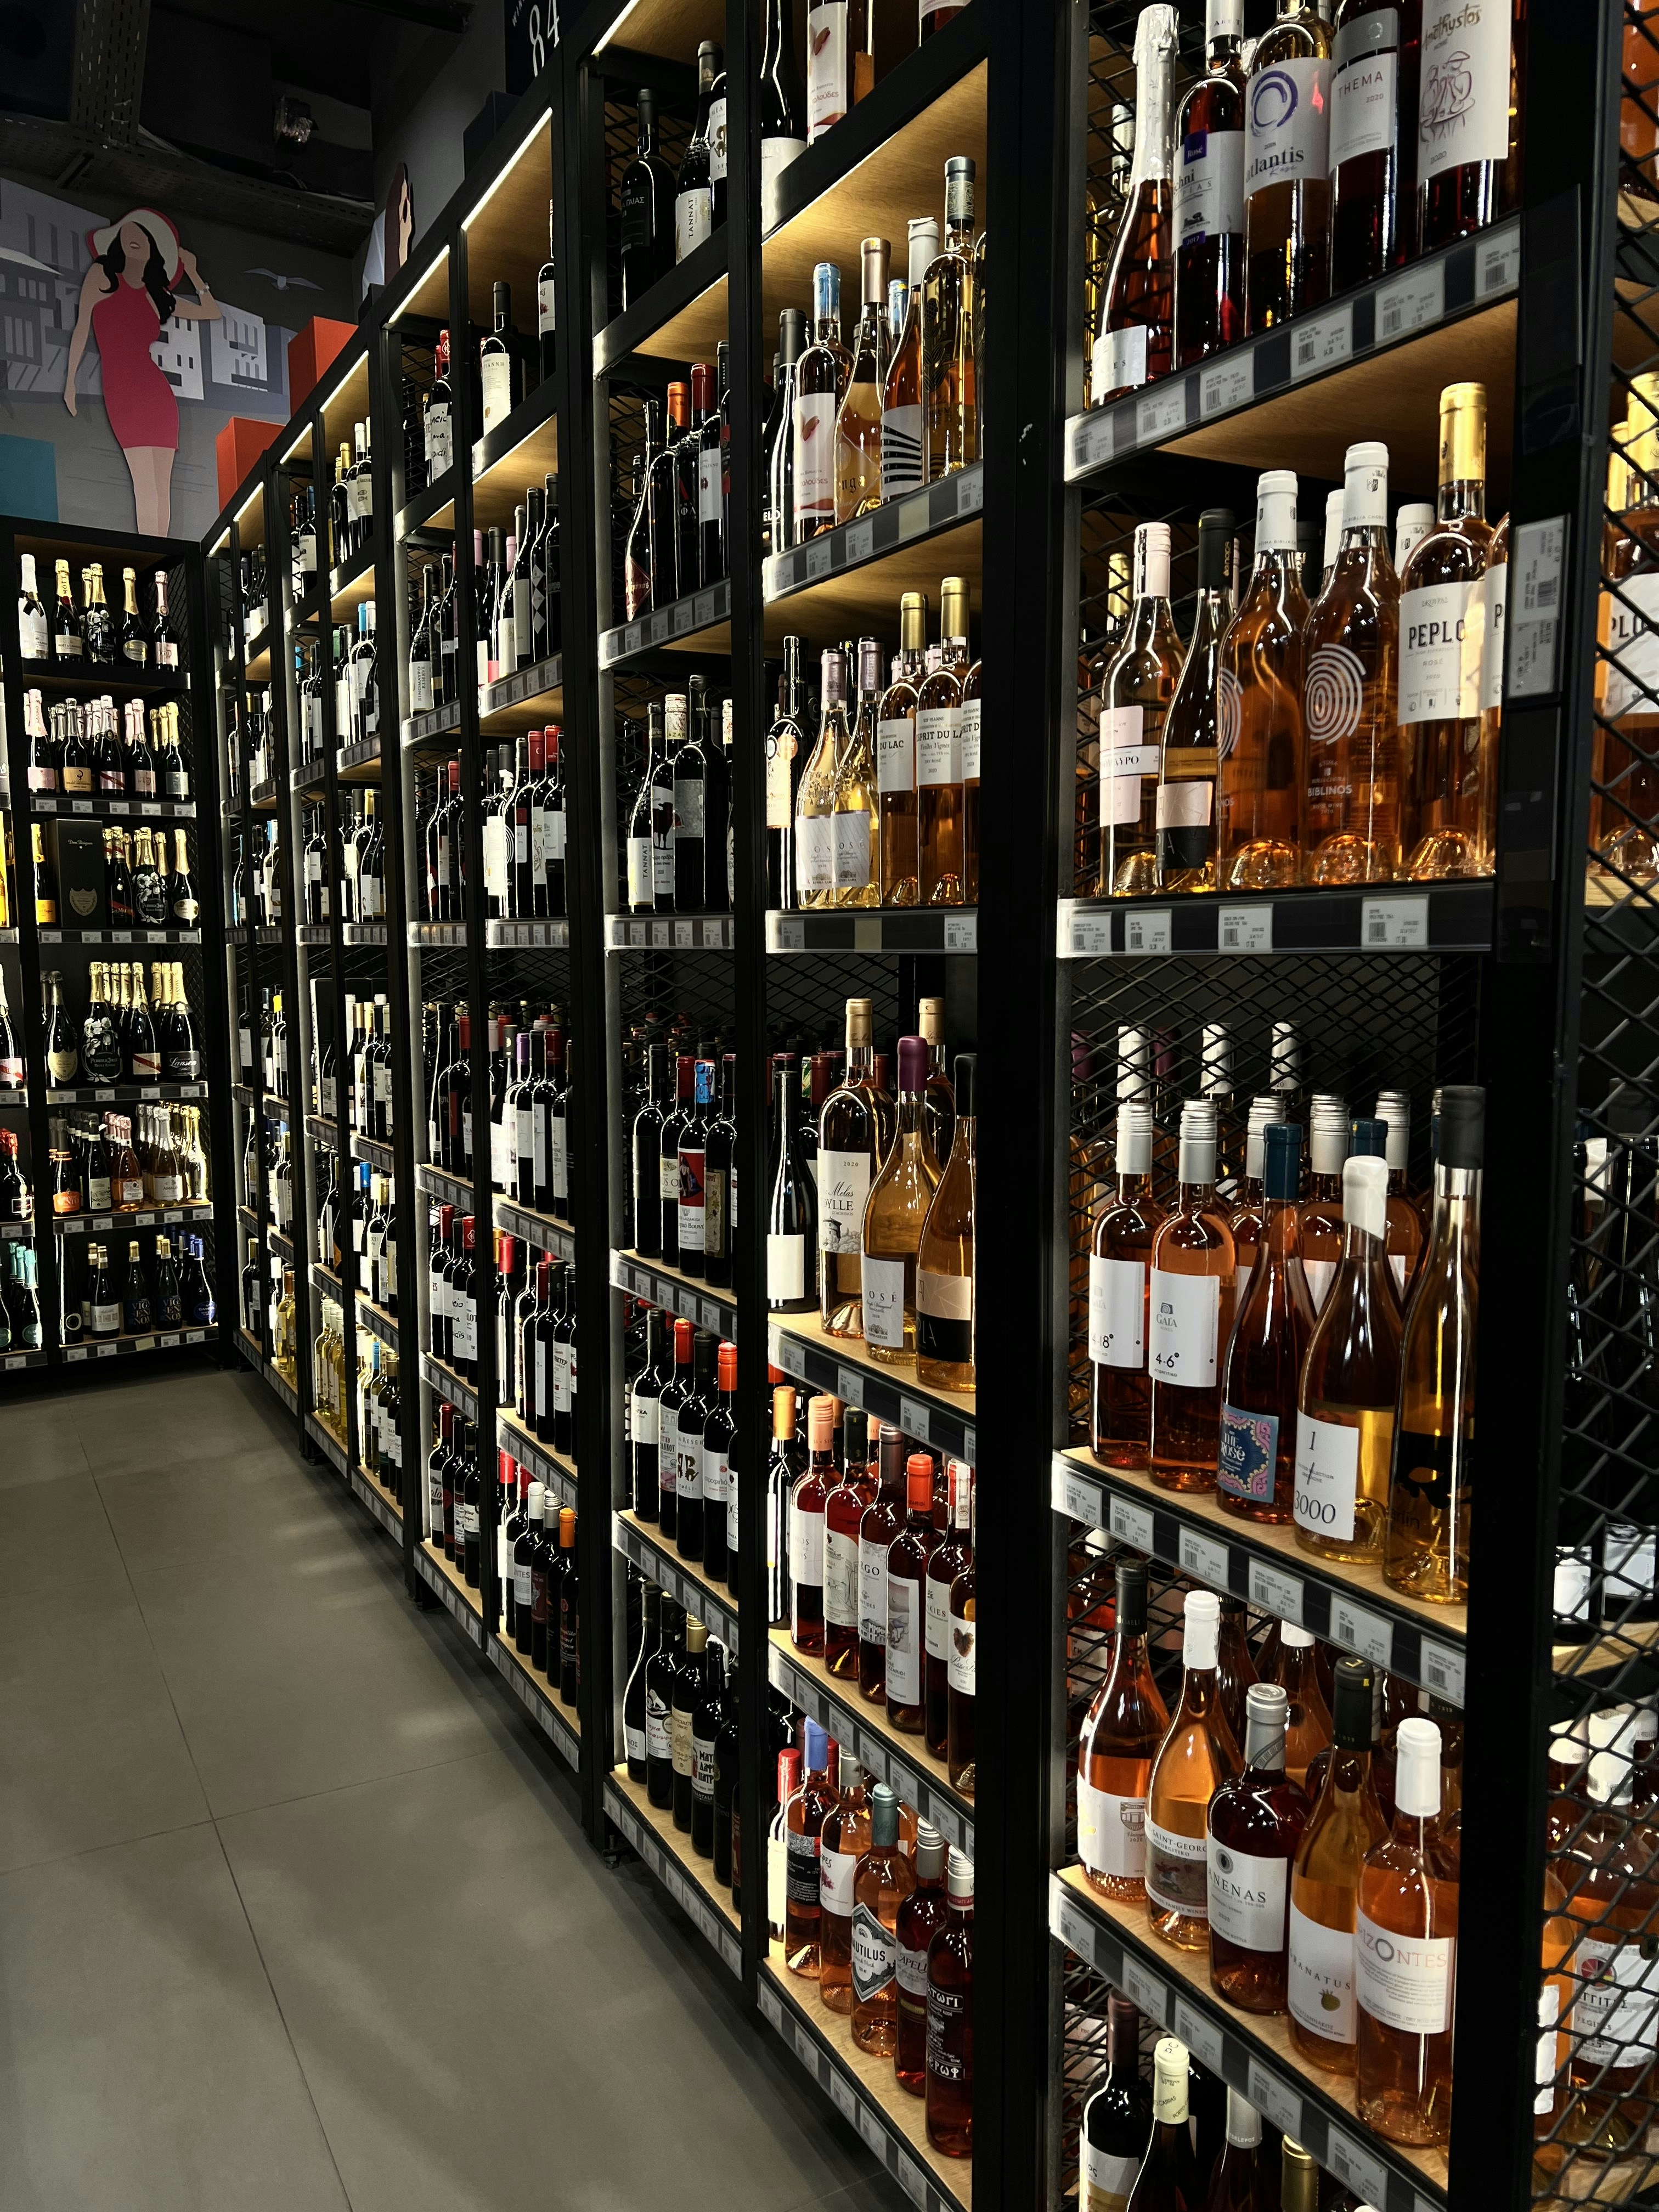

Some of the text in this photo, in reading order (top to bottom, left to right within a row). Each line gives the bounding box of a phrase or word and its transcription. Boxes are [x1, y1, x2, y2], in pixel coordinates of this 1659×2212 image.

[1338, 71, 1383, 98] THEMA
[1365, 93, 1384, 103] 2020
[1246, 146, 1304, 182] atlantis
[1430, 151, 1447, 164] 2020
[880, 740, 904, 750] DU LAC
[1308, 785, 1352, 797] BIBLINOS
[169, 1057, 197, 1068] Lanson
[829, 1182, 854, 1197] Melas
[1309, 1431, 1316, 1451] 1
[1294, 1490, 1336, 1523] 3000
[1159, 2096, 1177, 2106] CARRAS
